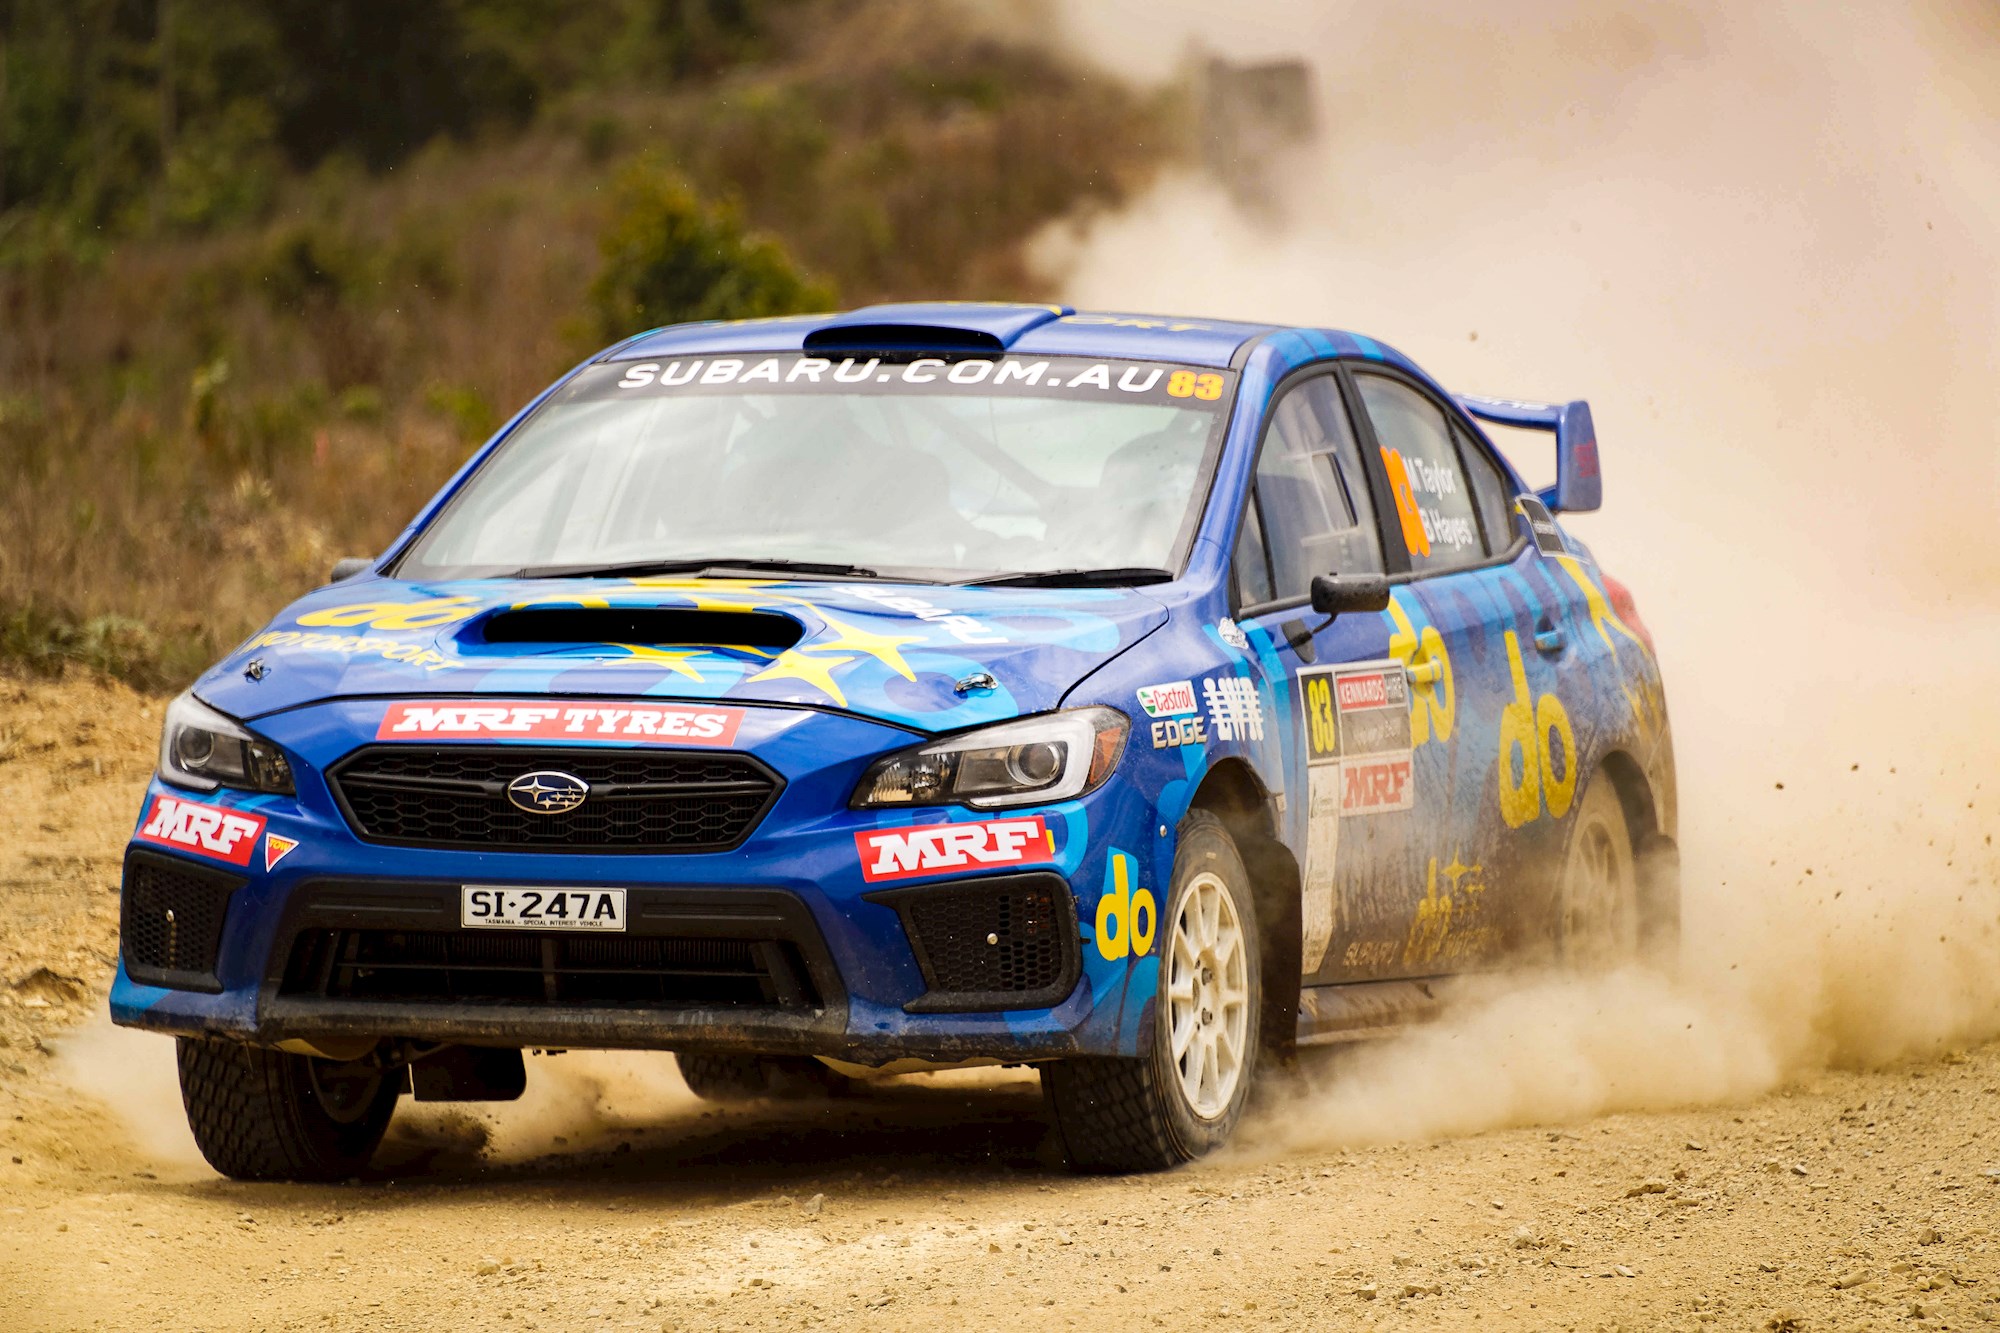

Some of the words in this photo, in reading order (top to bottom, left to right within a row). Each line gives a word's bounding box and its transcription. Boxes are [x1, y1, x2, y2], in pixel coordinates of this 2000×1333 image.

[618, 358, 1164, 392] SUBARU.COM.AU
[1166, 369, 1225, 401] 83
[1153, 686, 1194, 713] Castrol
[1308, 678, 1335, 753] 83
[392, 707, 559, 733] MRF
[564, 709, 728, 738] TYRES
[1150, 716, 1208, 749] EDGE
[1500, 629, 1577, 829] do
[1343, 760, 1411, 809] MRF
[143, 798, 260, 855] MRF
[269, 838, 293, 852] TOW
[868, 820, 1039, 875] MRF
[1095, 853, 1157, 961] do
